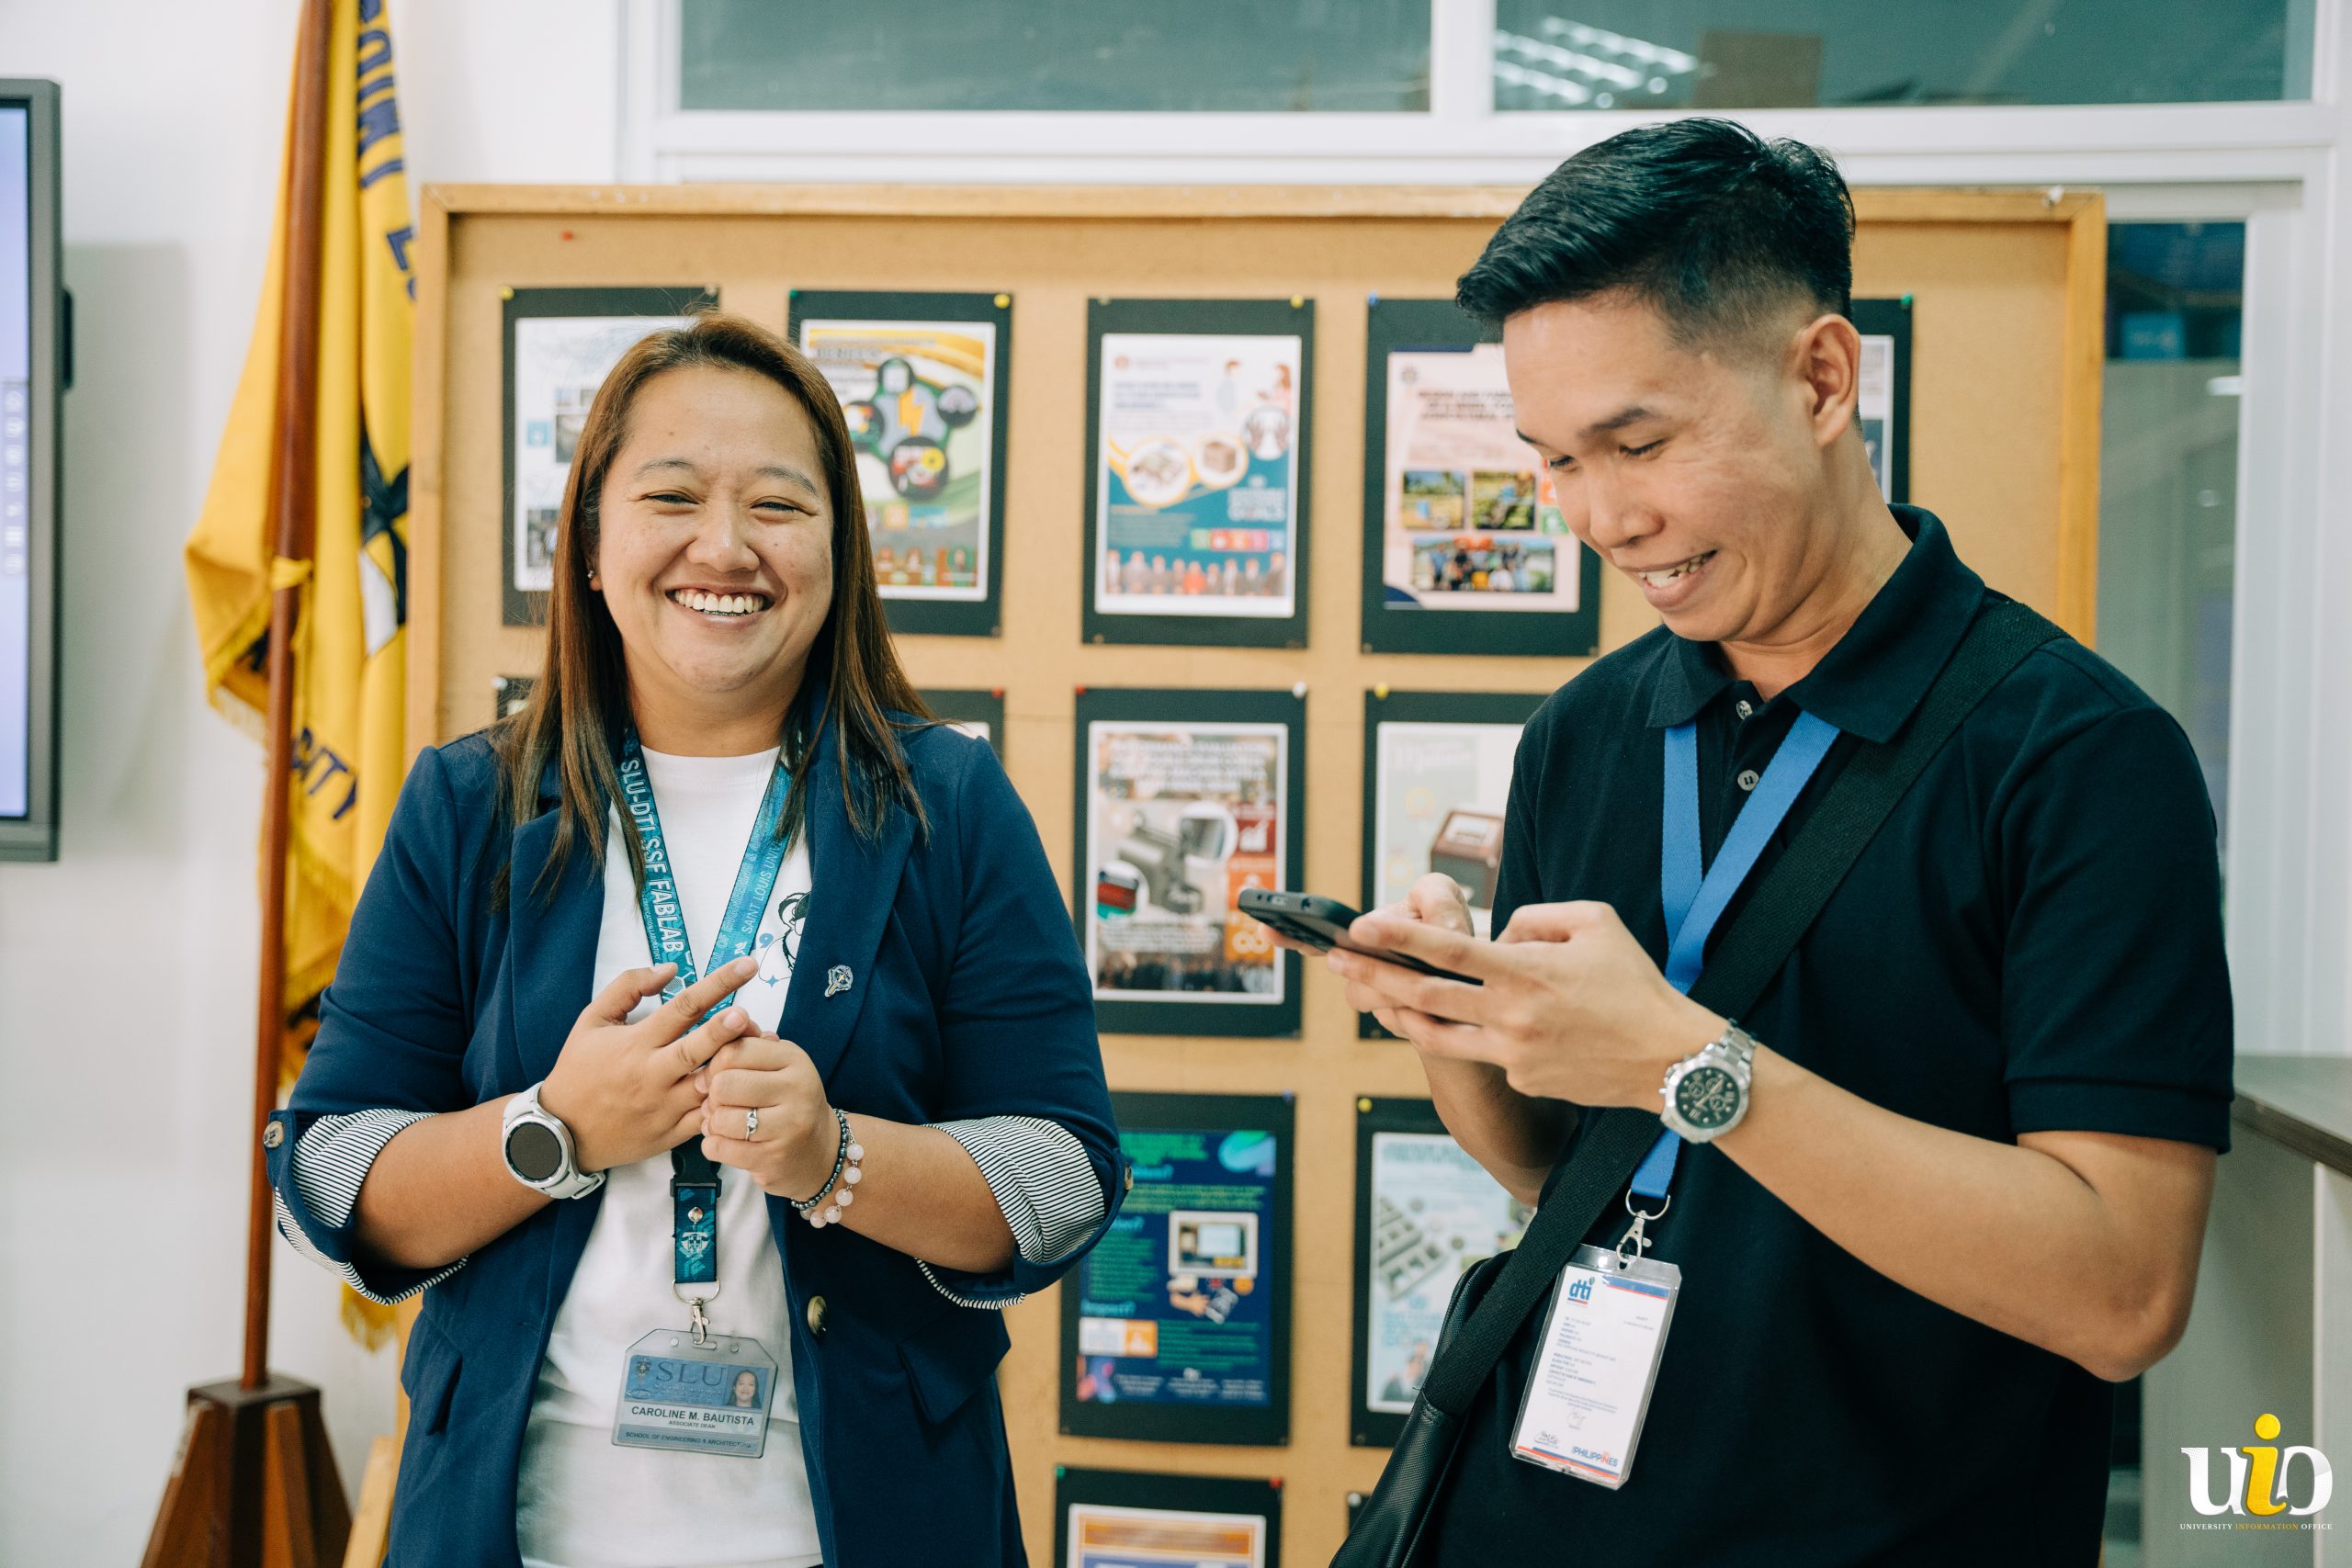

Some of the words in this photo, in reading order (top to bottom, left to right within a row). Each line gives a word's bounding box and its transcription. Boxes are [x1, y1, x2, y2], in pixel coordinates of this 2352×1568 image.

[620, 757, 656, 832] SLU-DTI
[641, 836, 668, 874] SSF
[647, 878, 685, 953] FABLAB
[741, 903, 761, 934] SAINT
[754, 870, 773, 902] LOUIS
[656, 1360, 728, 1386] SLU
[631, 1405, 686, 1420] CAROLINE
[688, 1411, 700, 1421] M.
[703, 1413, 754, 1426] BAUTISTA
[669, 1420, 699, 1428] ASSOCIATE
[626, 1431, 650, 1439] SCHOOL
[661, 1435, 702, 1444] ENGINEERING
